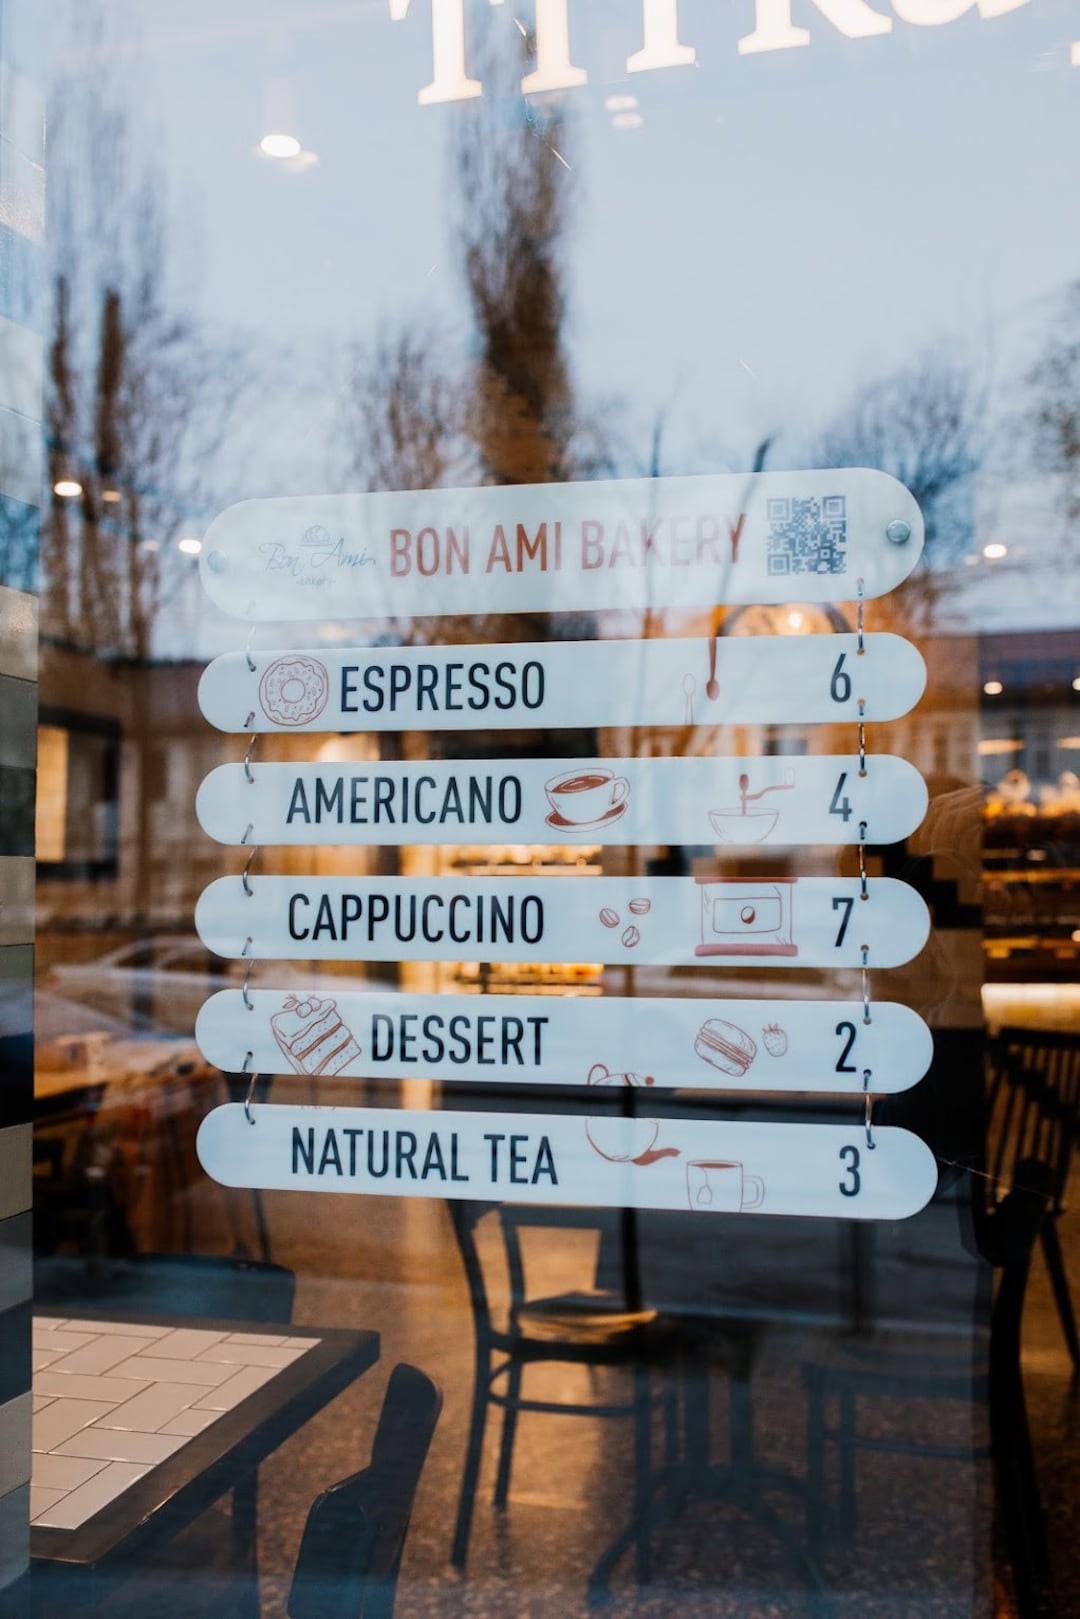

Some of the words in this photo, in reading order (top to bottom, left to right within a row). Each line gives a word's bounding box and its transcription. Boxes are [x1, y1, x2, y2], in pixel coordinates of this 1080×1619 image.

[390, 526, 470, 577] BON
[485, 521, 562, 573] AMI
[581, 513, 746, 570] BAKERY
[340, 661, 545, 712] ESPRESSO
[830, 653, 851, 703] 6
[286, 775, 522, 824] AMERICANO
[829, 772, 852, 822] 4
[288, 893, 544, 944] CAPPUCCINO
[832, 897, 854, 947] 7
[371, 1013, 549, 1065] DESSERT
[834, 1021, 857, 1073] 2
[291, 1126, 469, 1181] NATURAL
[484, 1134, 559, 1185] TEA
[838, 1145, 861, 1196] 3
